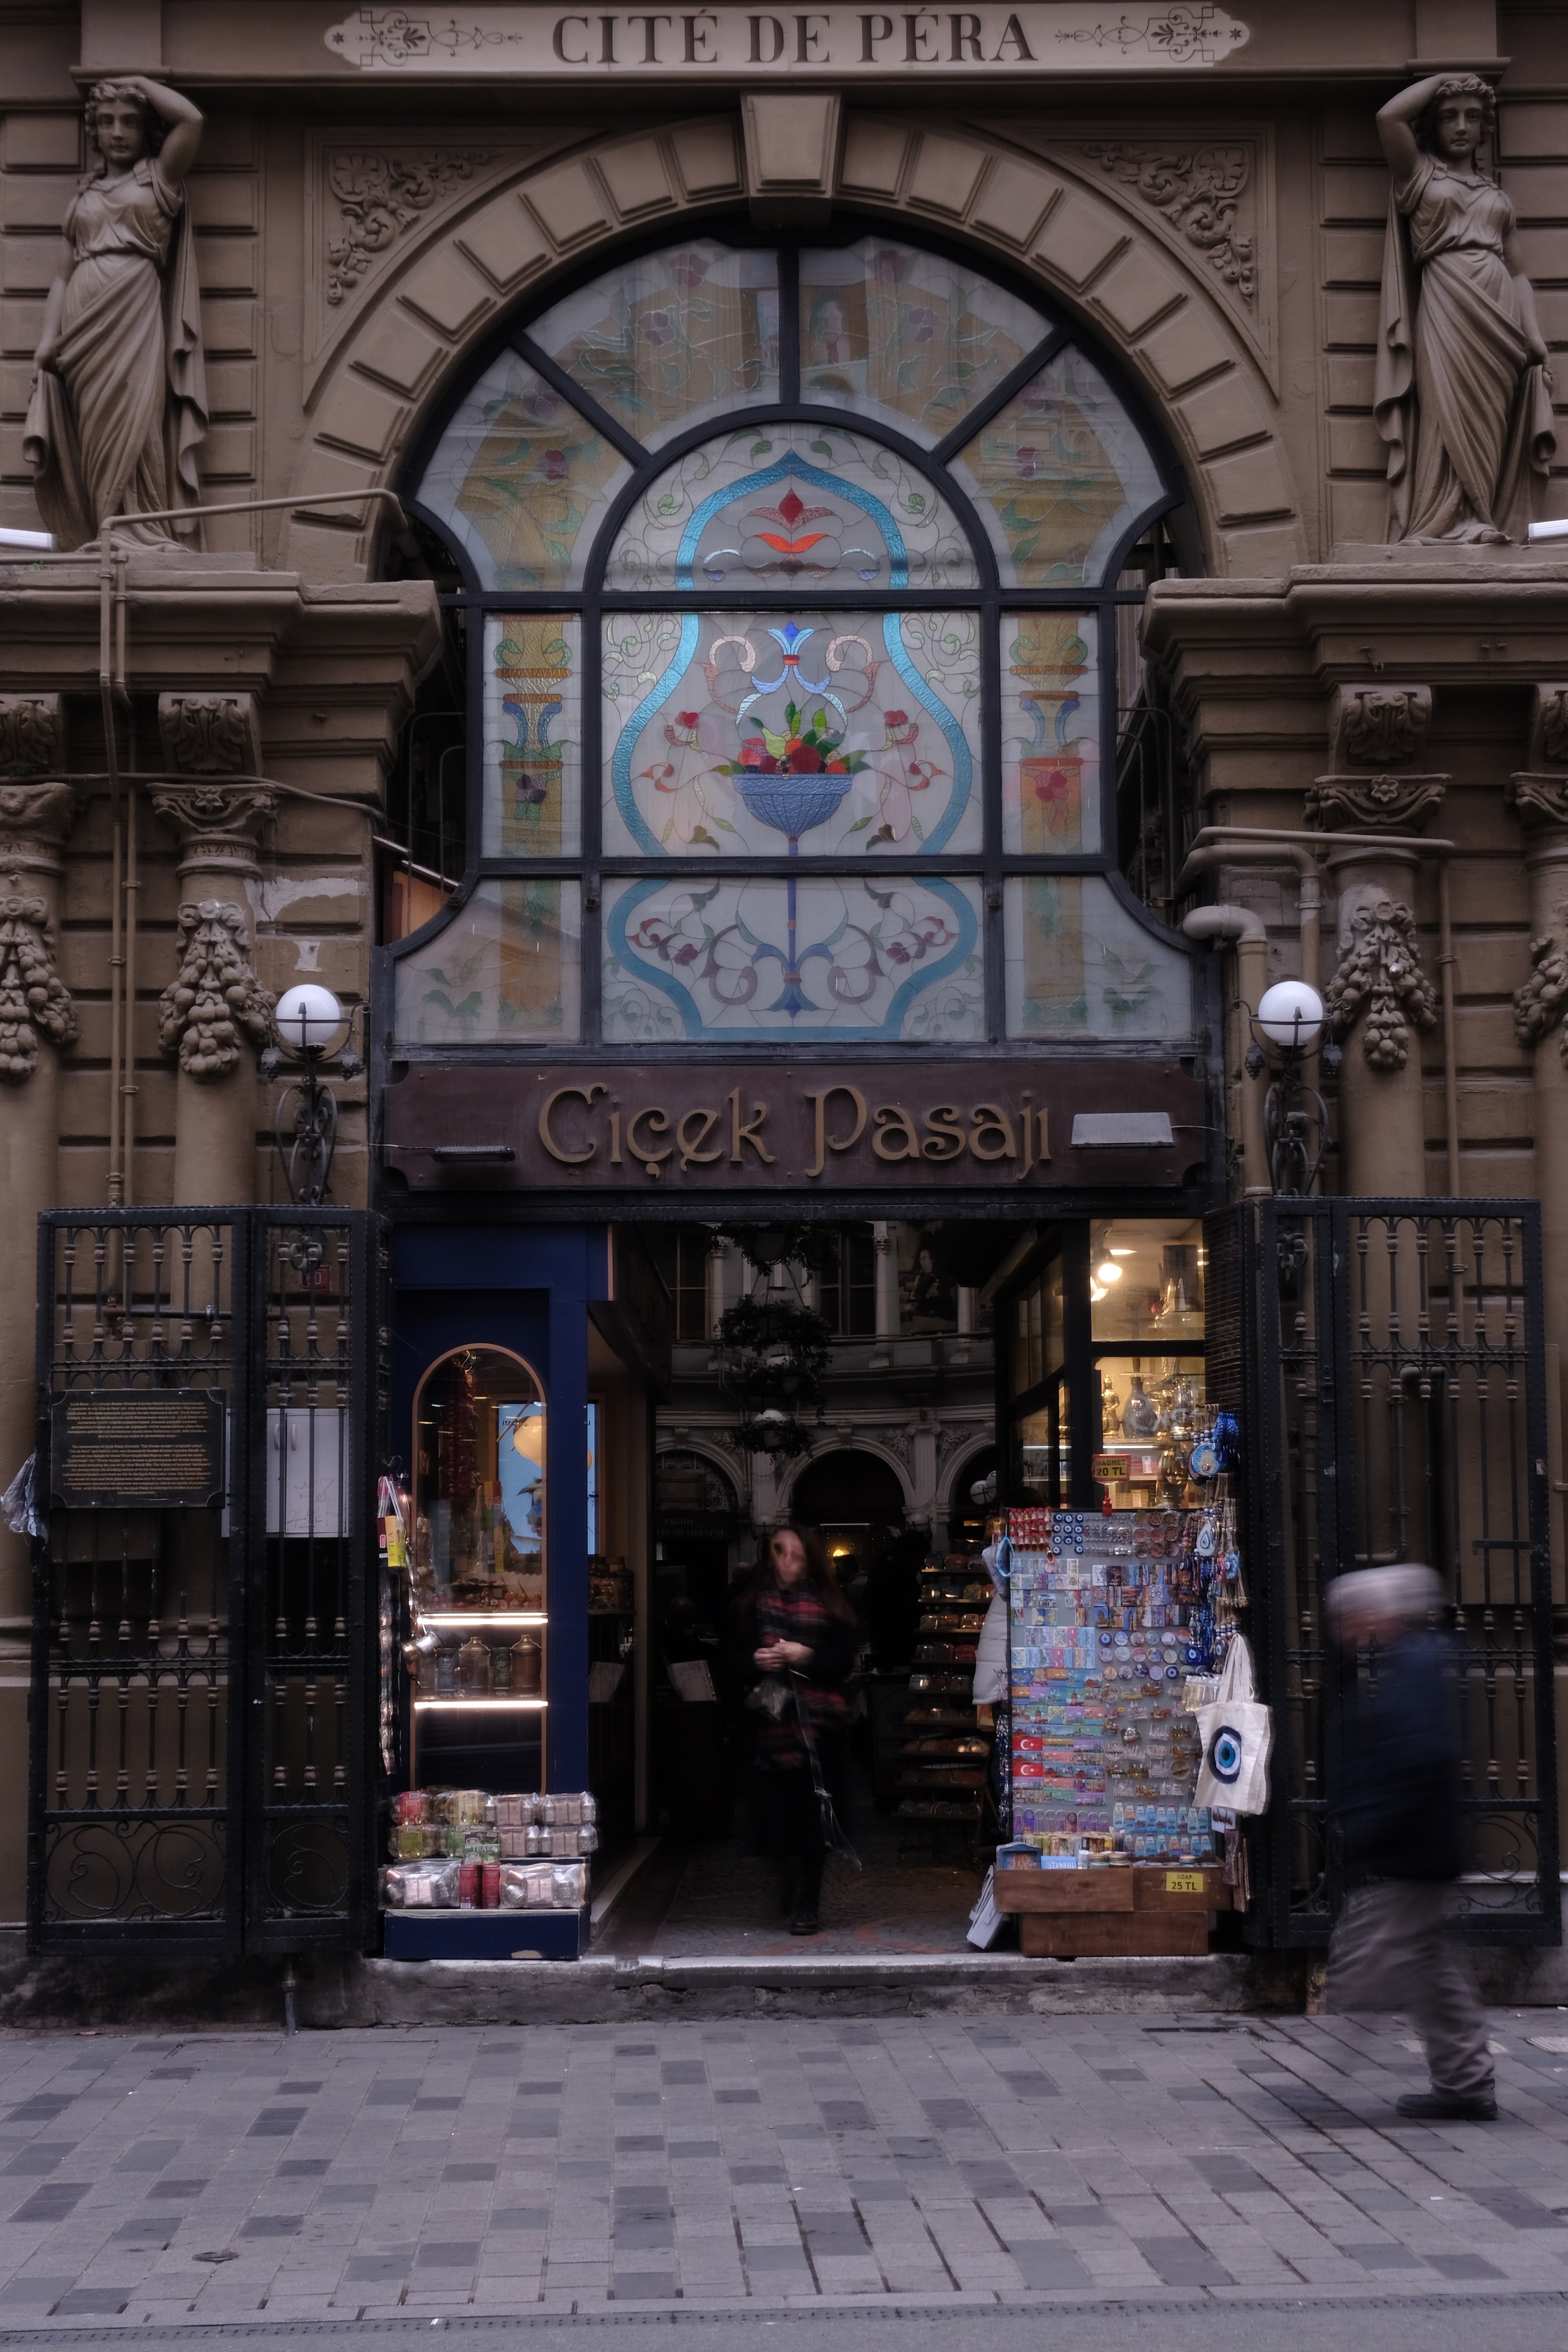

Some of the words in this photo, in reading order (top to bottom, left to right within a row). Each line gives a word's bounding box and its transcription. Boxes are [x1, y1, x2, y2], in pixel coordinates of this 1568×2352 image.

[553, 8, 717, 64] CITÉ
[745, 15, 830, 63] DE
[856, 7, 1039, 63] PÉRA
[804, 1085, 1051, 1180] Pasajı
[1096, 1467, 1108, 1476] 20
[1112, 1467, 1125, 1476] TL
[1171, 1882, 1182, 1890] 25
[1185, 1882, 1197, 1890] TL
